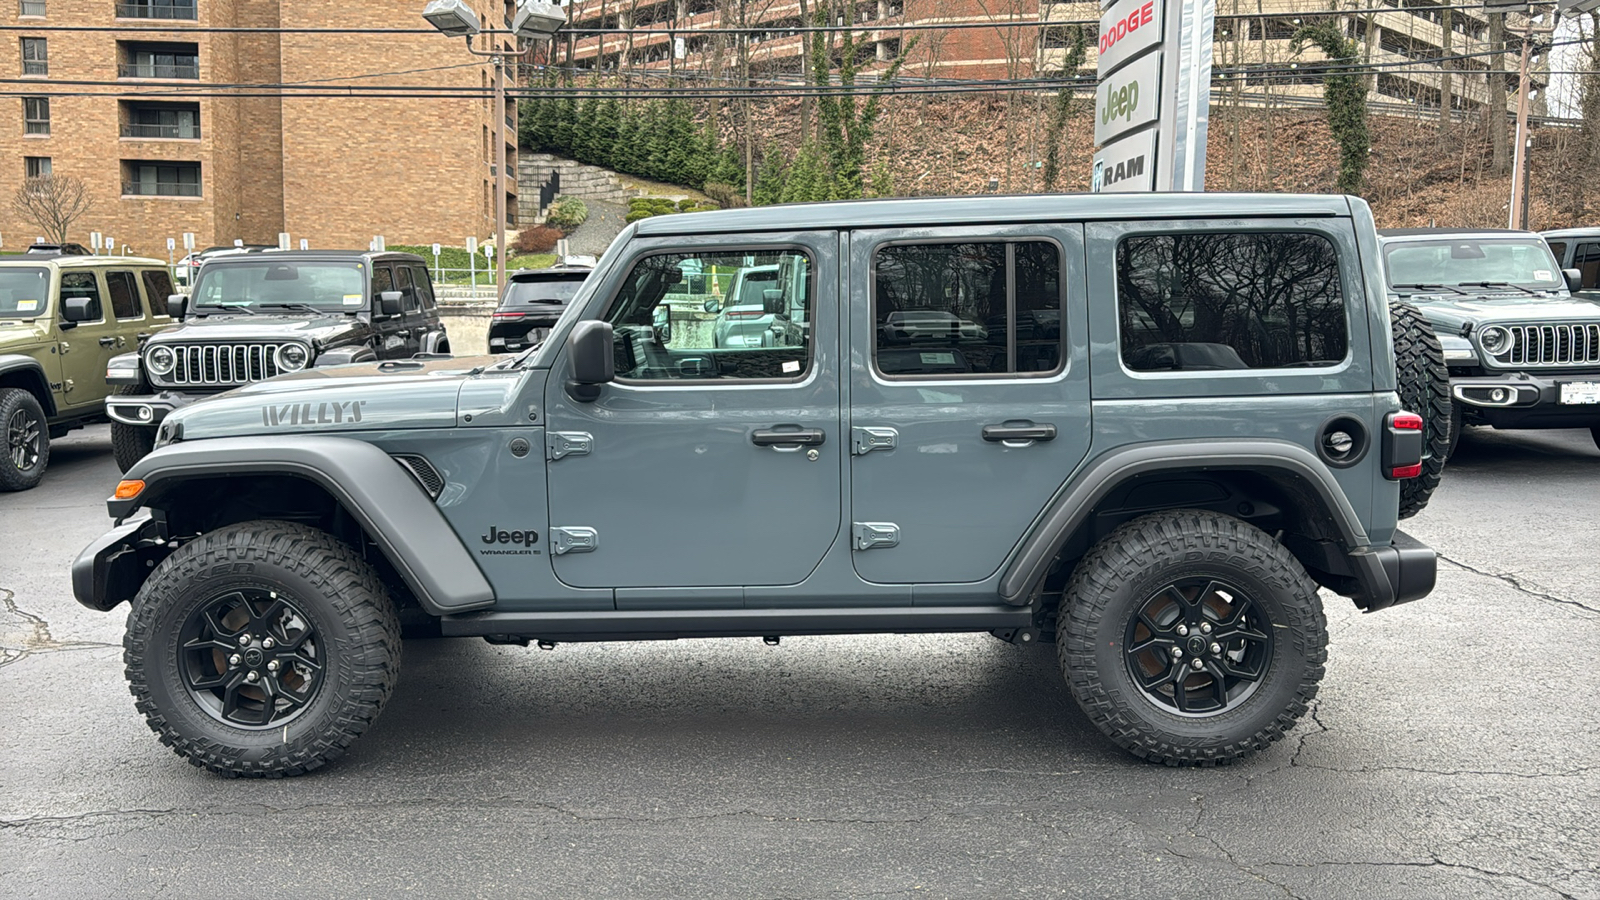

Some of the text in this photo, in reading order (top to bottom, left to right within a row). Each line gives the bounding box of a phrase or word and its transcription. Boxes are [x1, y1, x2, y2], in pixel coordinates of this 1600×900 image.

[1100, 2, 1153, 55] DODGE
[1102, 80, 1139, 125] Jeep
[1103, 155, 1145, 187] RAM
[262, 400, 367, 427] WILLYS
[481, 525, 539, 548] Jeep
[1130, 551, 1285, 592] WILDPEAK
[260, 637, 351, 760] WILDPEAK
